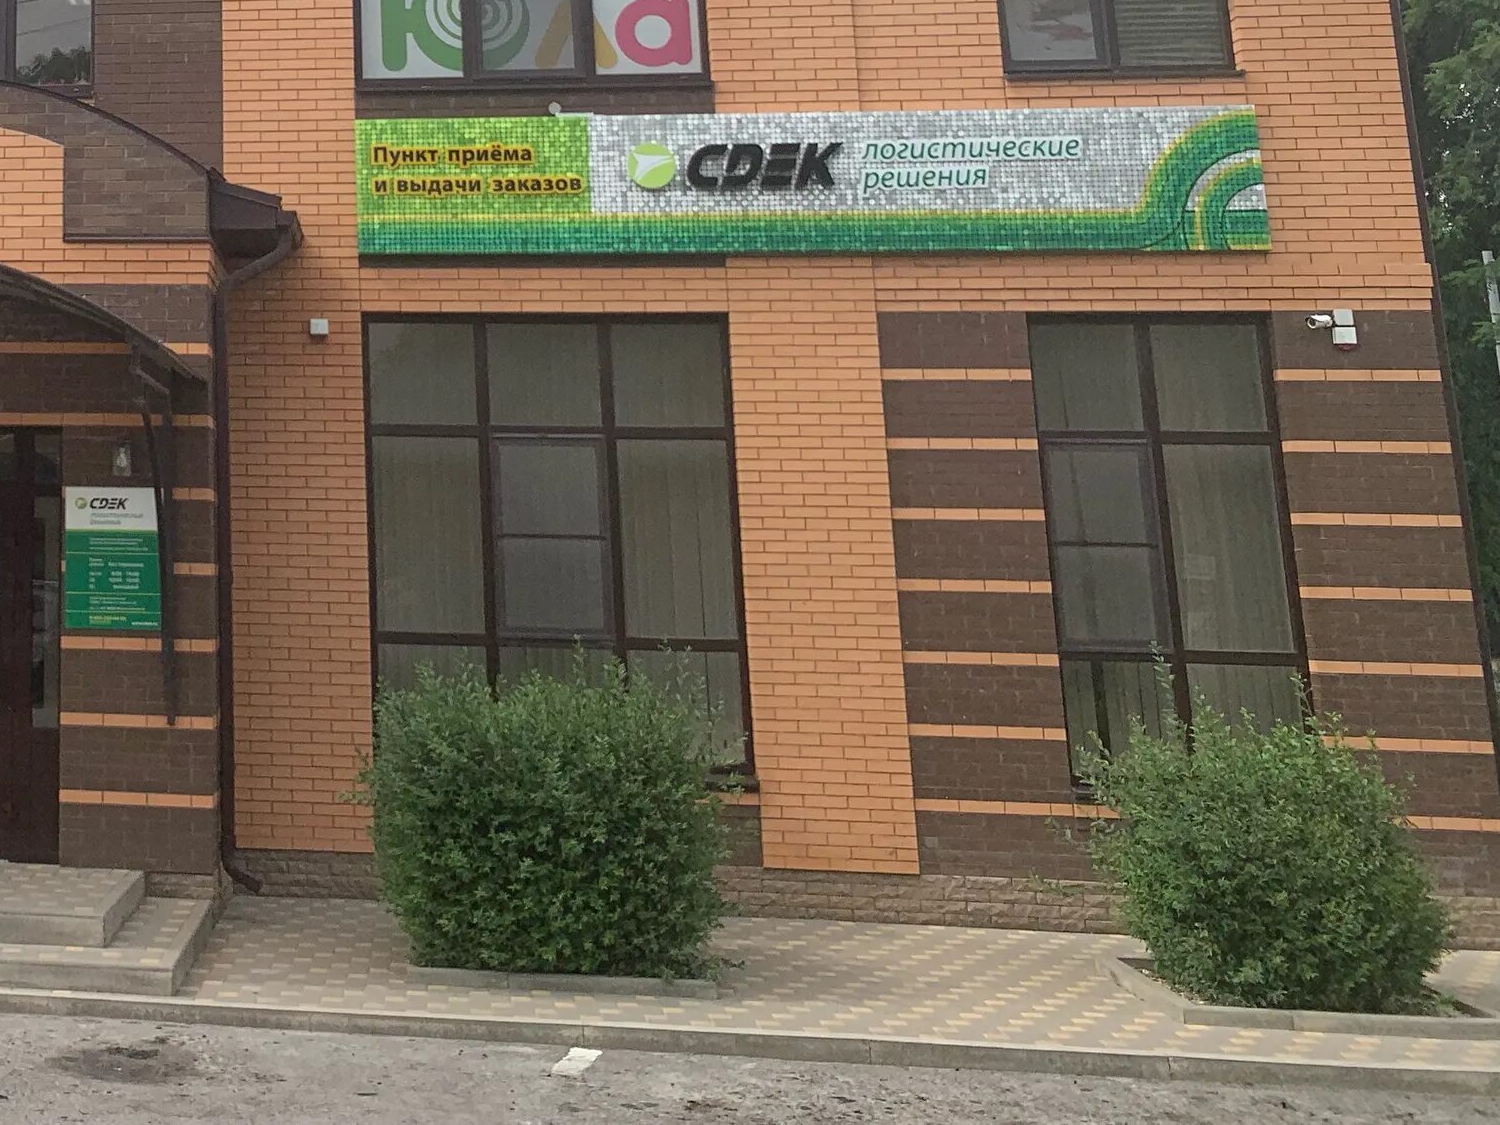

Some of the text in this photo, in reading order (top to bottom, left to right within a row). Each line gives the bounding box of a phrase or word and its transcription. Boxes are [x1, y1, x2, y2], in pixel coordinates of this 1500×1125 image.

[372, 144, 533, 168] Пункт приёма
[862, 137, 1081, 161] логистические
[686, 141, 843, 190] CDEK
[374, 176, 583, 196] и выдачи заказов
[862, 166, 987, 194] решения
[89, 497, 129, 510] CDEK
